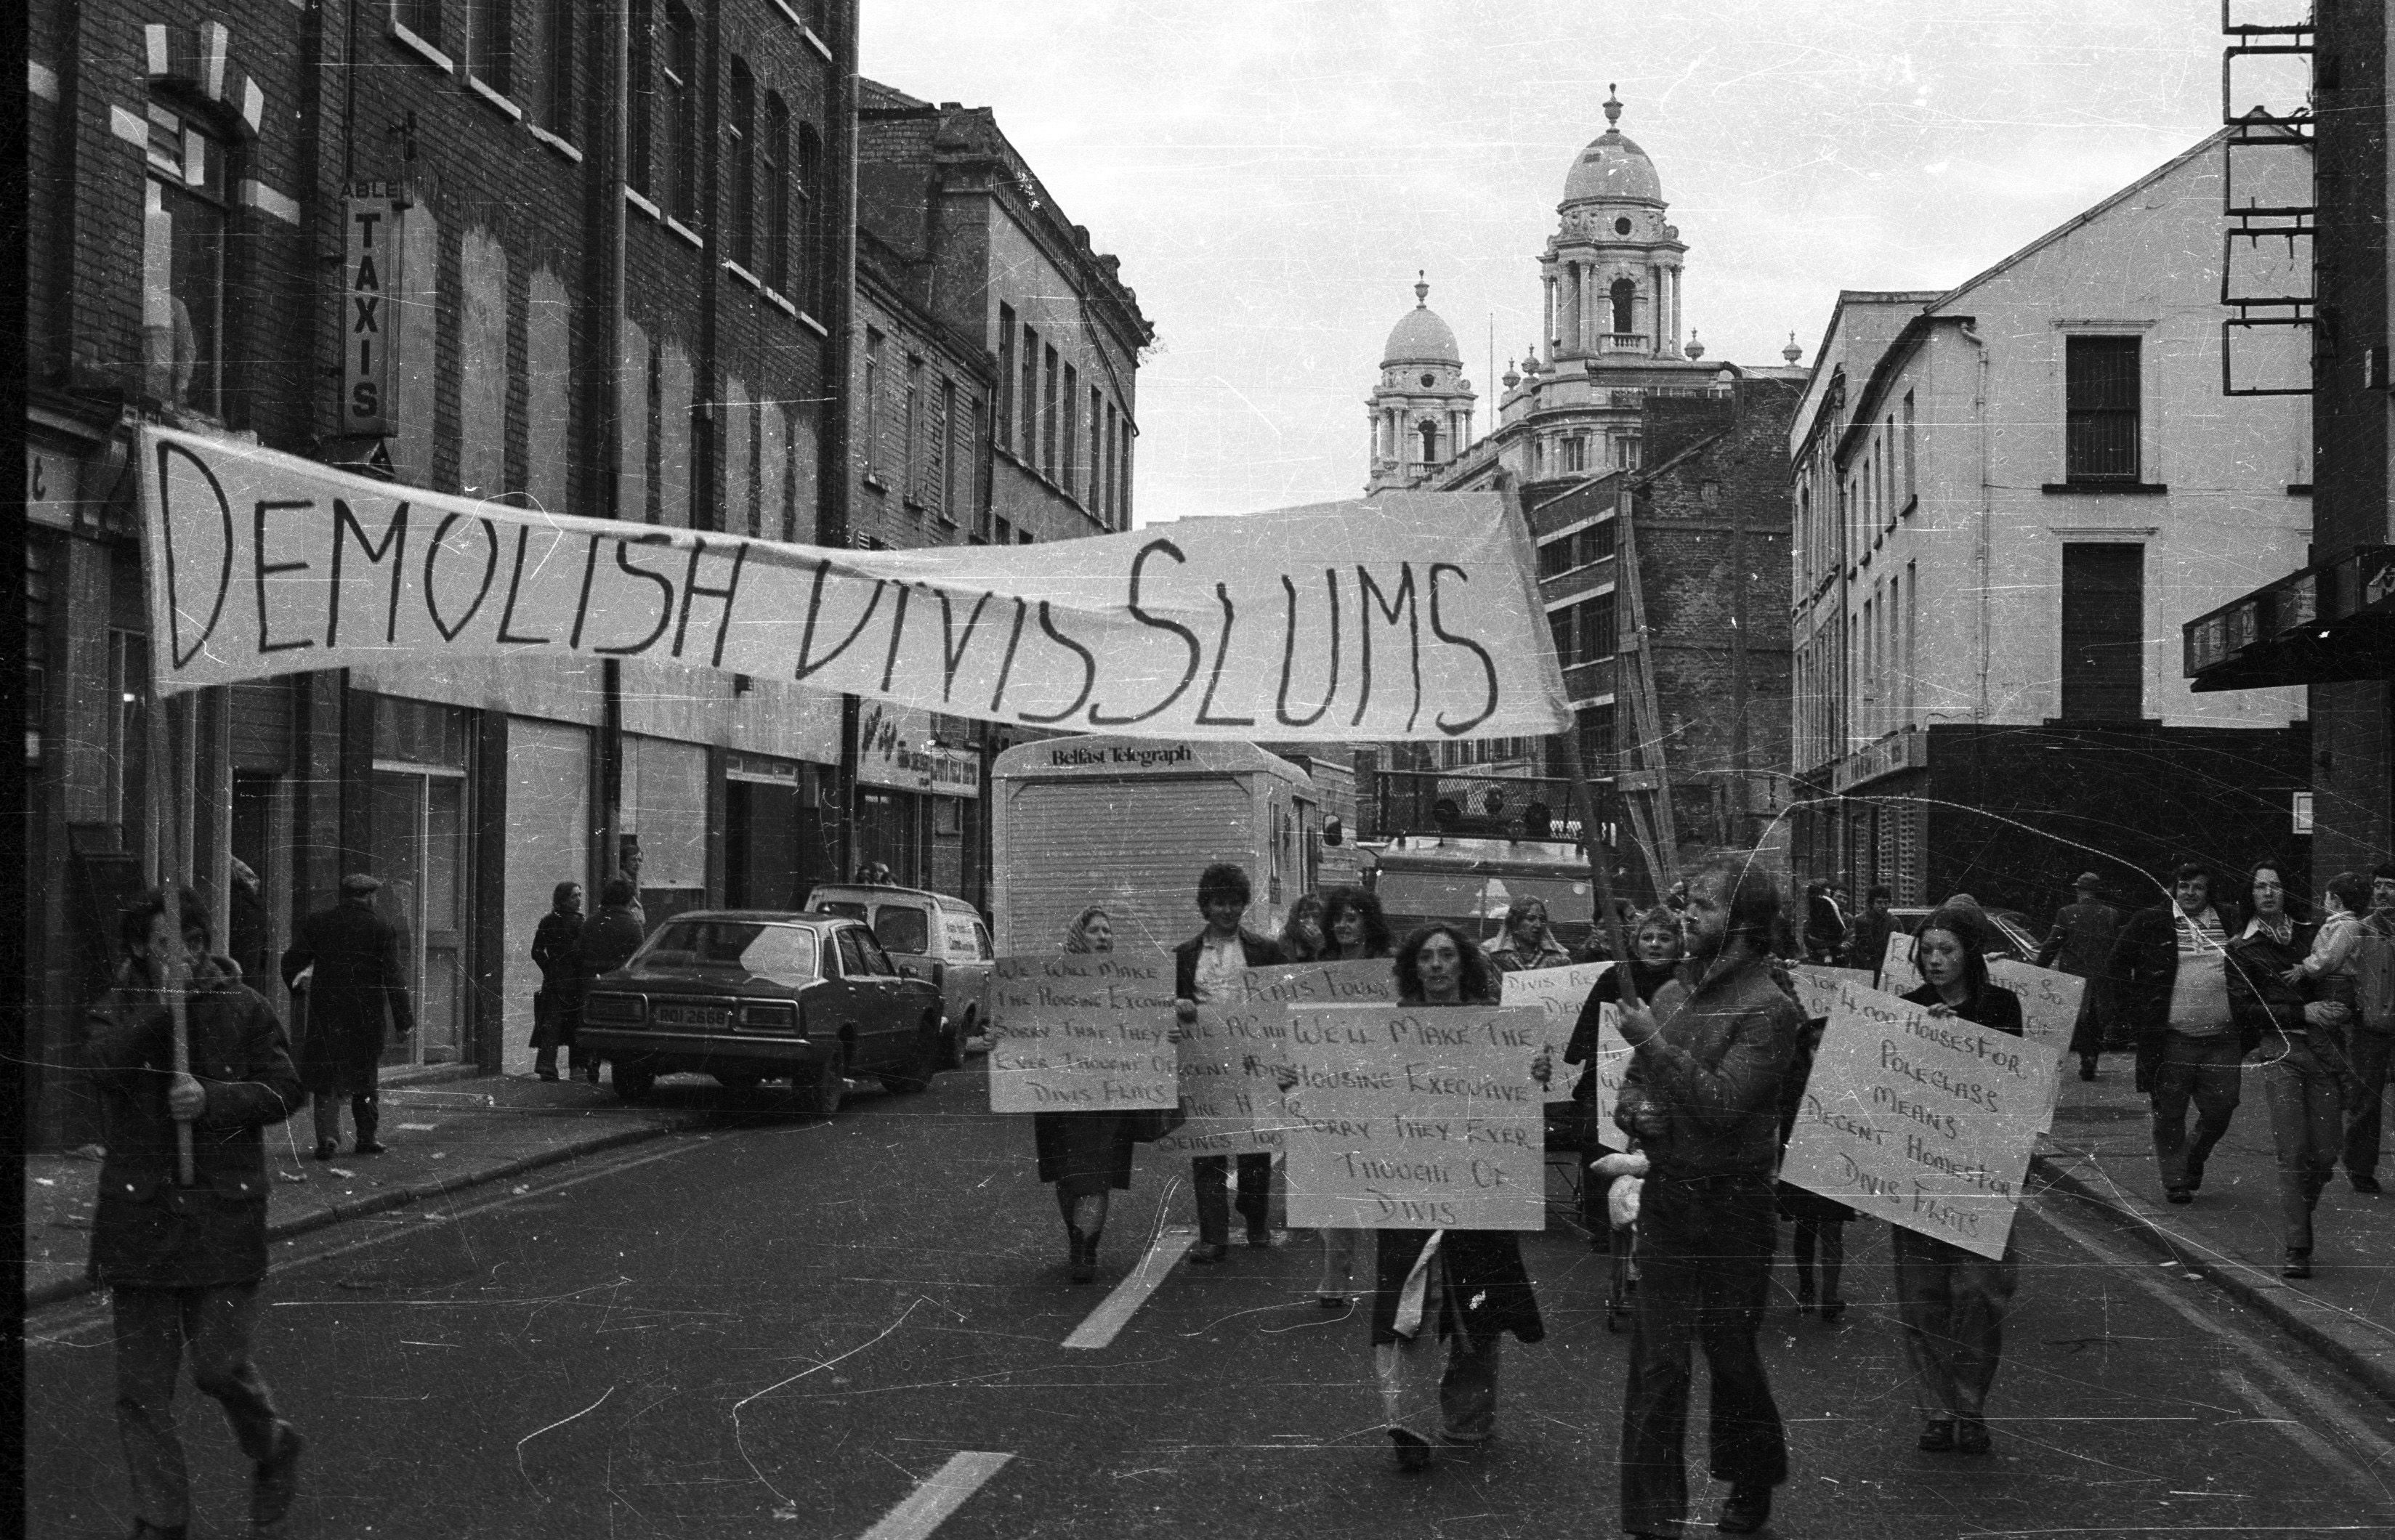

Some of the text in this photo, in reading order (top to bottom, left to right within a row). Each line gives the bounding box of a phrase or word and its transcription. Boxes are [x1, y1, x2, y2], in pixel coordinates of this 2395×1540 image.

[340, 181, 400, 198] ABLE
[352, 212, 381, 418] TAXIS
[156, 439, 1500, 735] DEMOLISH DIVIS SLUMS
[1051, 745, 1192, 767] Belfast Telegraph
[1097, 960, 1158, 980] MAKE
[1389, 1016, 1473, 1046] MAKE
[1474, 1018, 1533, 1046] THE
[1905, 1010, 1974, 1053] HOUSES
[1977, 1036, 2028, 1080] FOR
[1405, 1061, 1530, 1103] EXECUTIVE
[1881, 1039, 1998, 1113] POLEGLASS
[1288, 1100, 1370, 1139] SORRY
[1394, 1114, 1450, 1141] THEY
[1466, 1118, 1536, 1150] EVER
[1873, 1086, 1957, 1140] MEANS
[1335, 1151, 1507, 1188] THOUGHT OF
[1806, 1094, 2019, 1205] DECENT HOMES FOR
[1365, 1187, 1457, 1225] DIVIS
[1834, 1151, 1981, 1238] DIVIS FLATS
